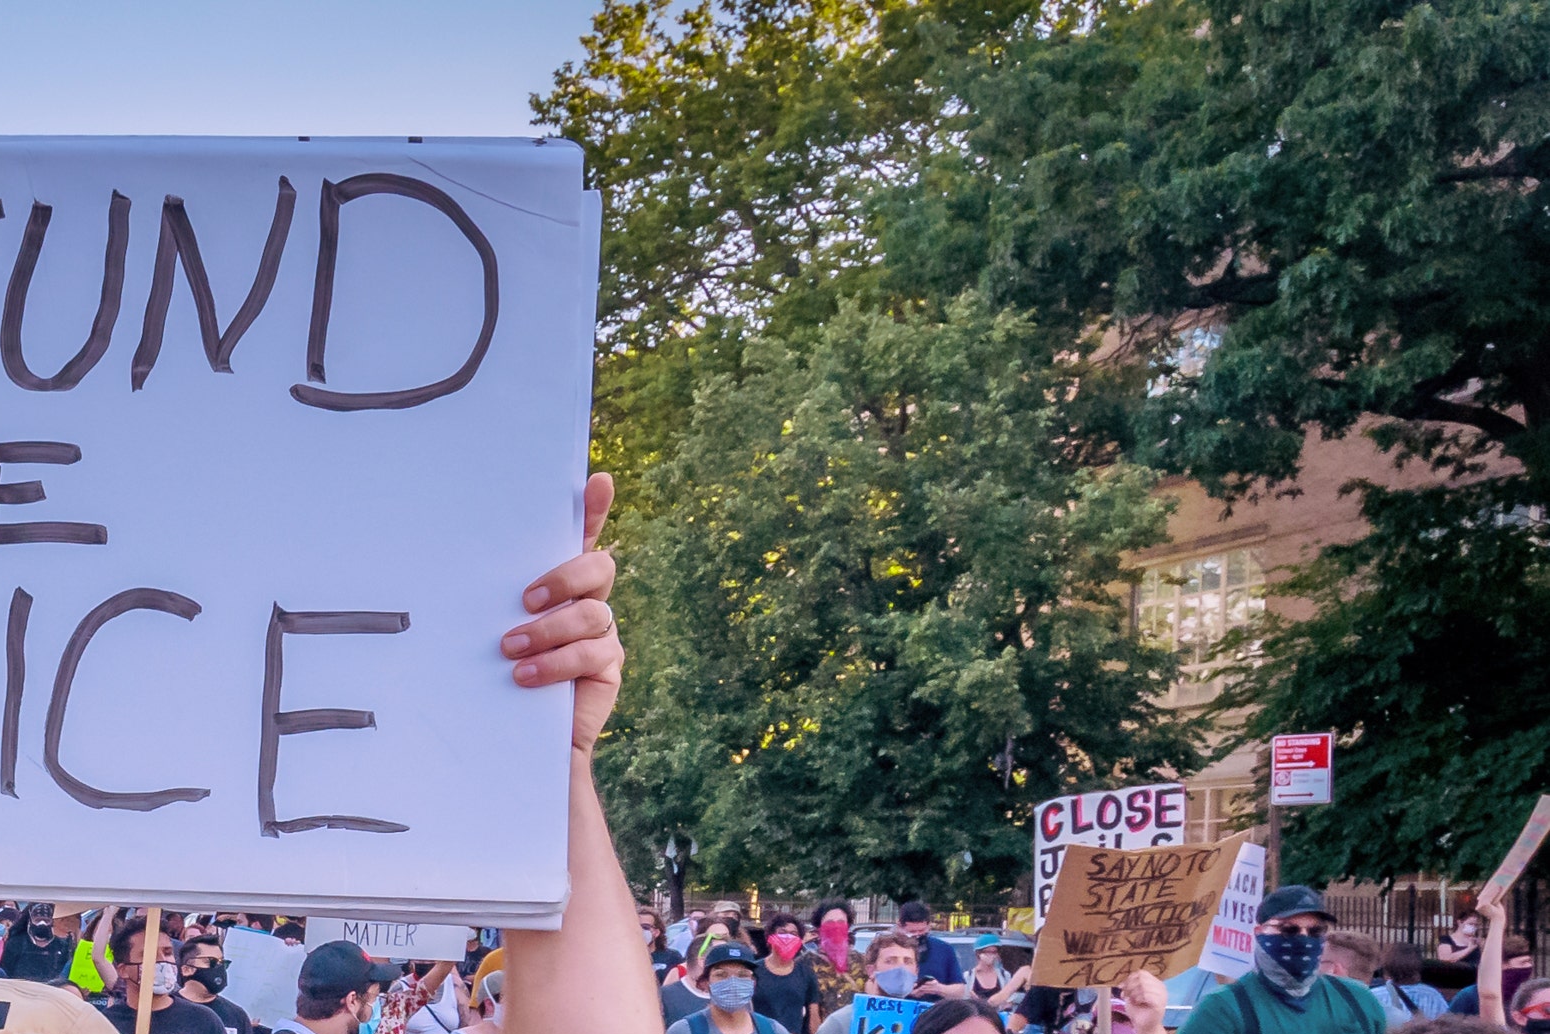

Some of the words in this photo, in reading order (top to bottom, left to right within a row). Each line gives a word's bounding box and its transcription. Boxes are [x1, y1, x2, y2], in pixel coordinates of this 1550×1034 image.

[1040, 786, 1185, 842] CLOSE
[1086, 852, 1141, 880] SAY
[1142, 852, 1182, 879] NO
[1183, 848, 1222, 878] TO
[1081, 878, 1183, 908] STATE
[1223, 898, 1255, 925] IVES
[343, 922, 418, 947] MATTER
[1212, 925, 1253, 954] MATTER
[866, 997, 904, 1014] Rest
